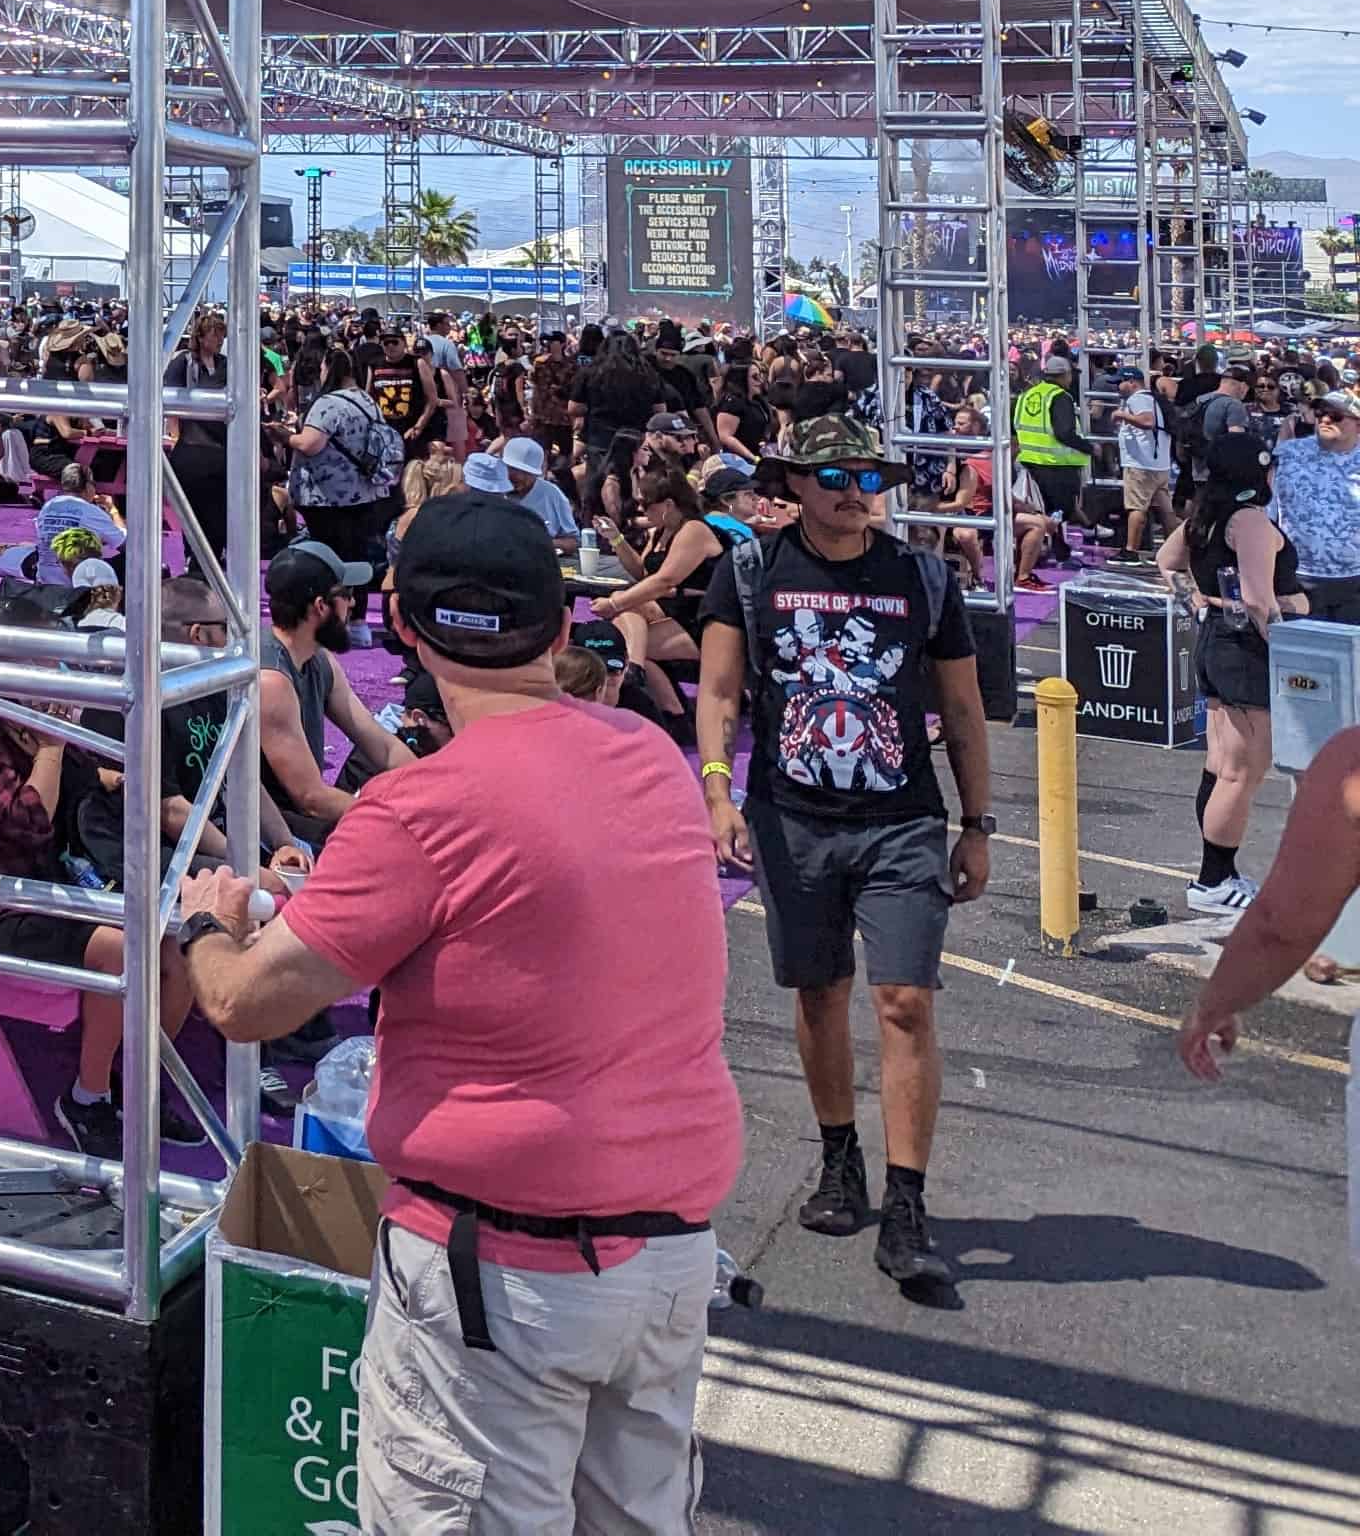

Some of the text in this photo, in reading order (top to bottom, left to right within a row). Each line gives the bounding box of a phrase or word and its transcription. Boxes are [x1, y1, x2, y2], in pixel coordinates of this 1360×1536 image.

[624, 159, 732, 176] ACCESSIBILITY
[648, 193, 706, 204] PLEASE VISIT
[638, 205, 717, 216] THE ACCESSIBILITY
[648, 217, 689, 228] SERVICES
[646, 228, 710, 240] NEAR THE MAIN
[650, 240, 707, 252] ENTRANCE TO
[651, 252, 689, 263] REQUEST
[648, 275, 664, 286] AND
[776, 593, 829, 610] SYSTEM
[832, 595, 849, 611] OF
[865, 597, 906, 615] DOWN
[1086, 612, 1145, 631] OTHER
[285, 1396, 323, 1445] &
